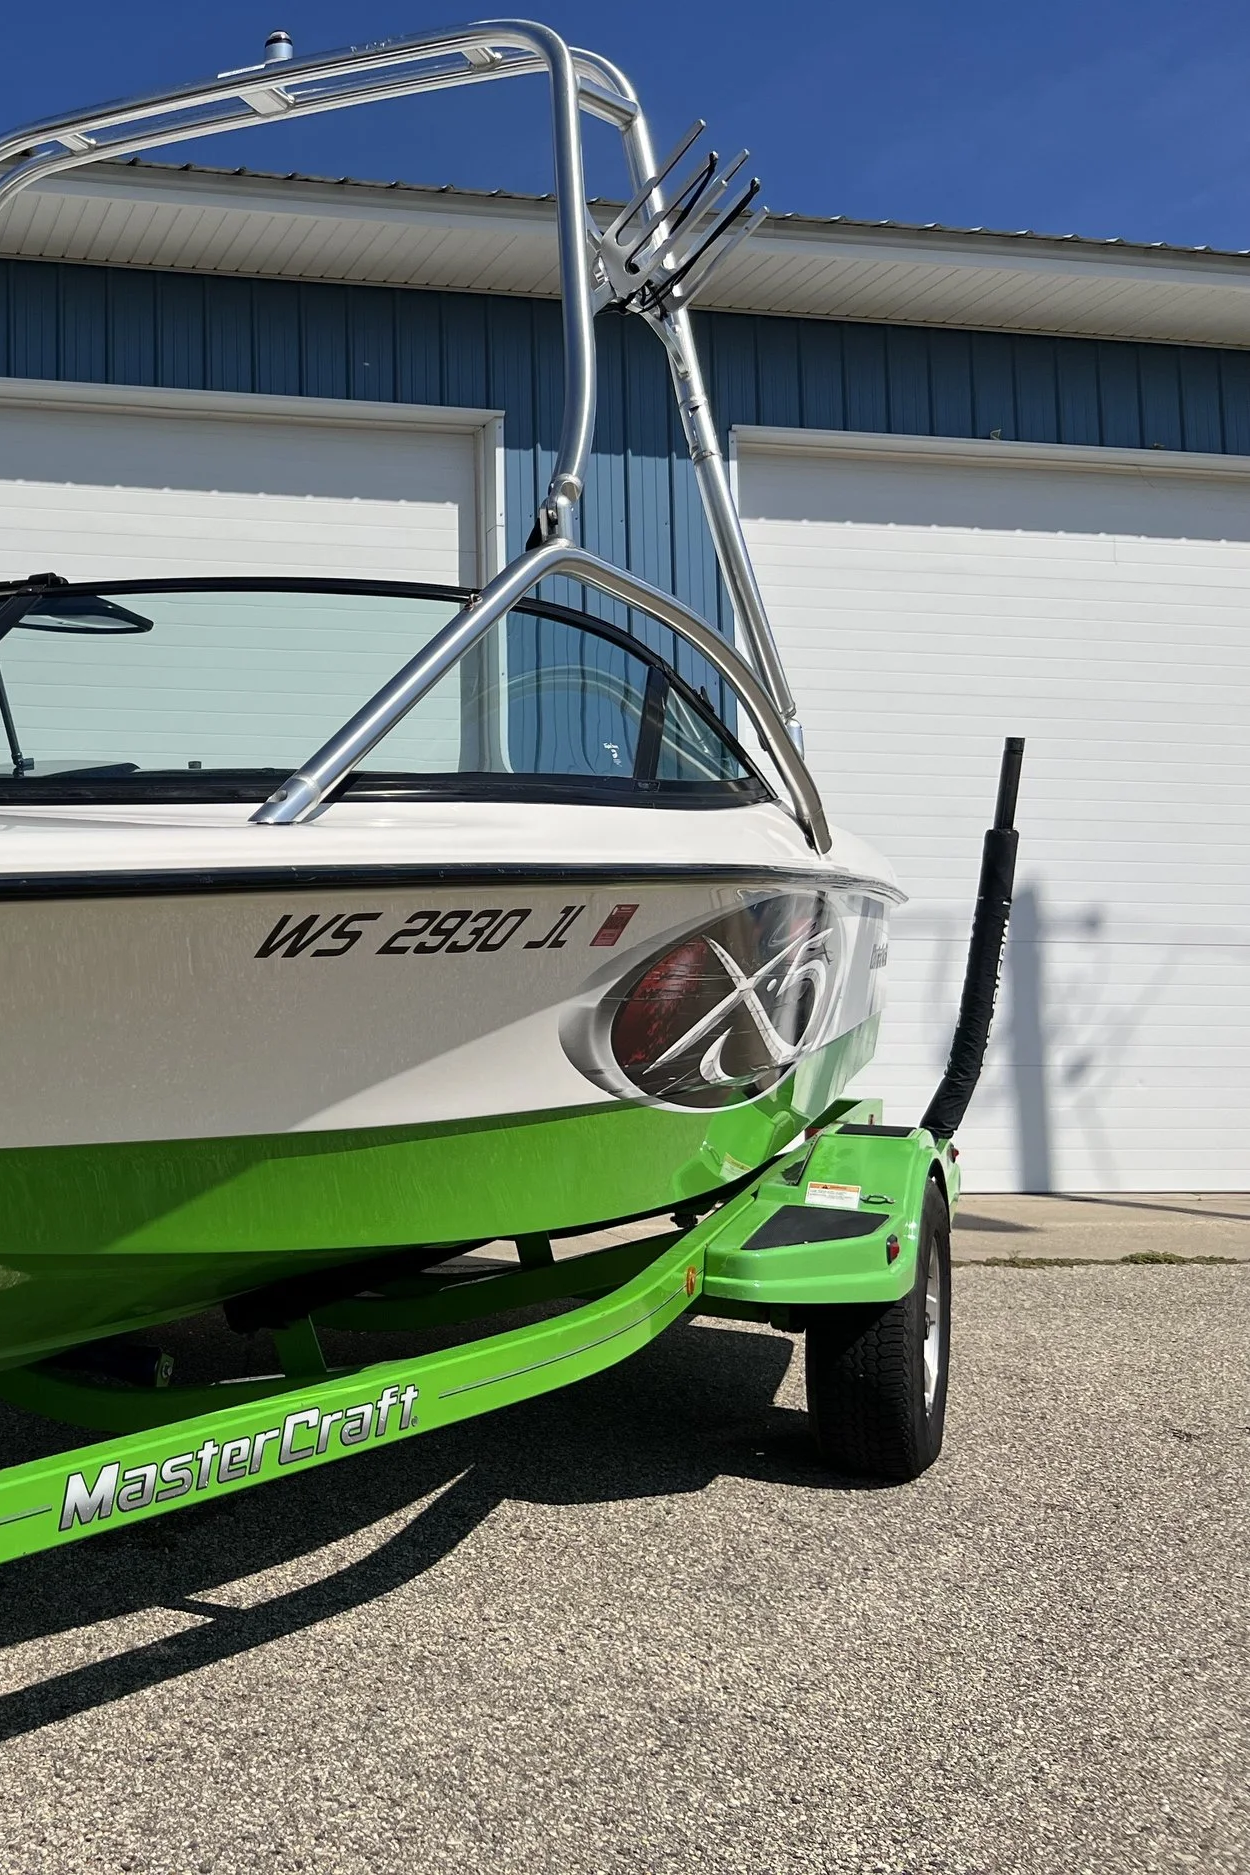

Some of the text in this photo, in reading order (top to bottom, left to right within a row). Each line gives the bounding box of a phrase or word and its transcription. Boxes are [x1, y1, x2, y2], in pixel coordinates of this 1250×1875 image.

[253, 911, 384, 958] WS
[375, 908, 533, 955] 2930
[522, 905, 586, 949] JL
[58, 1383, 420, 1532] MasterCraft
